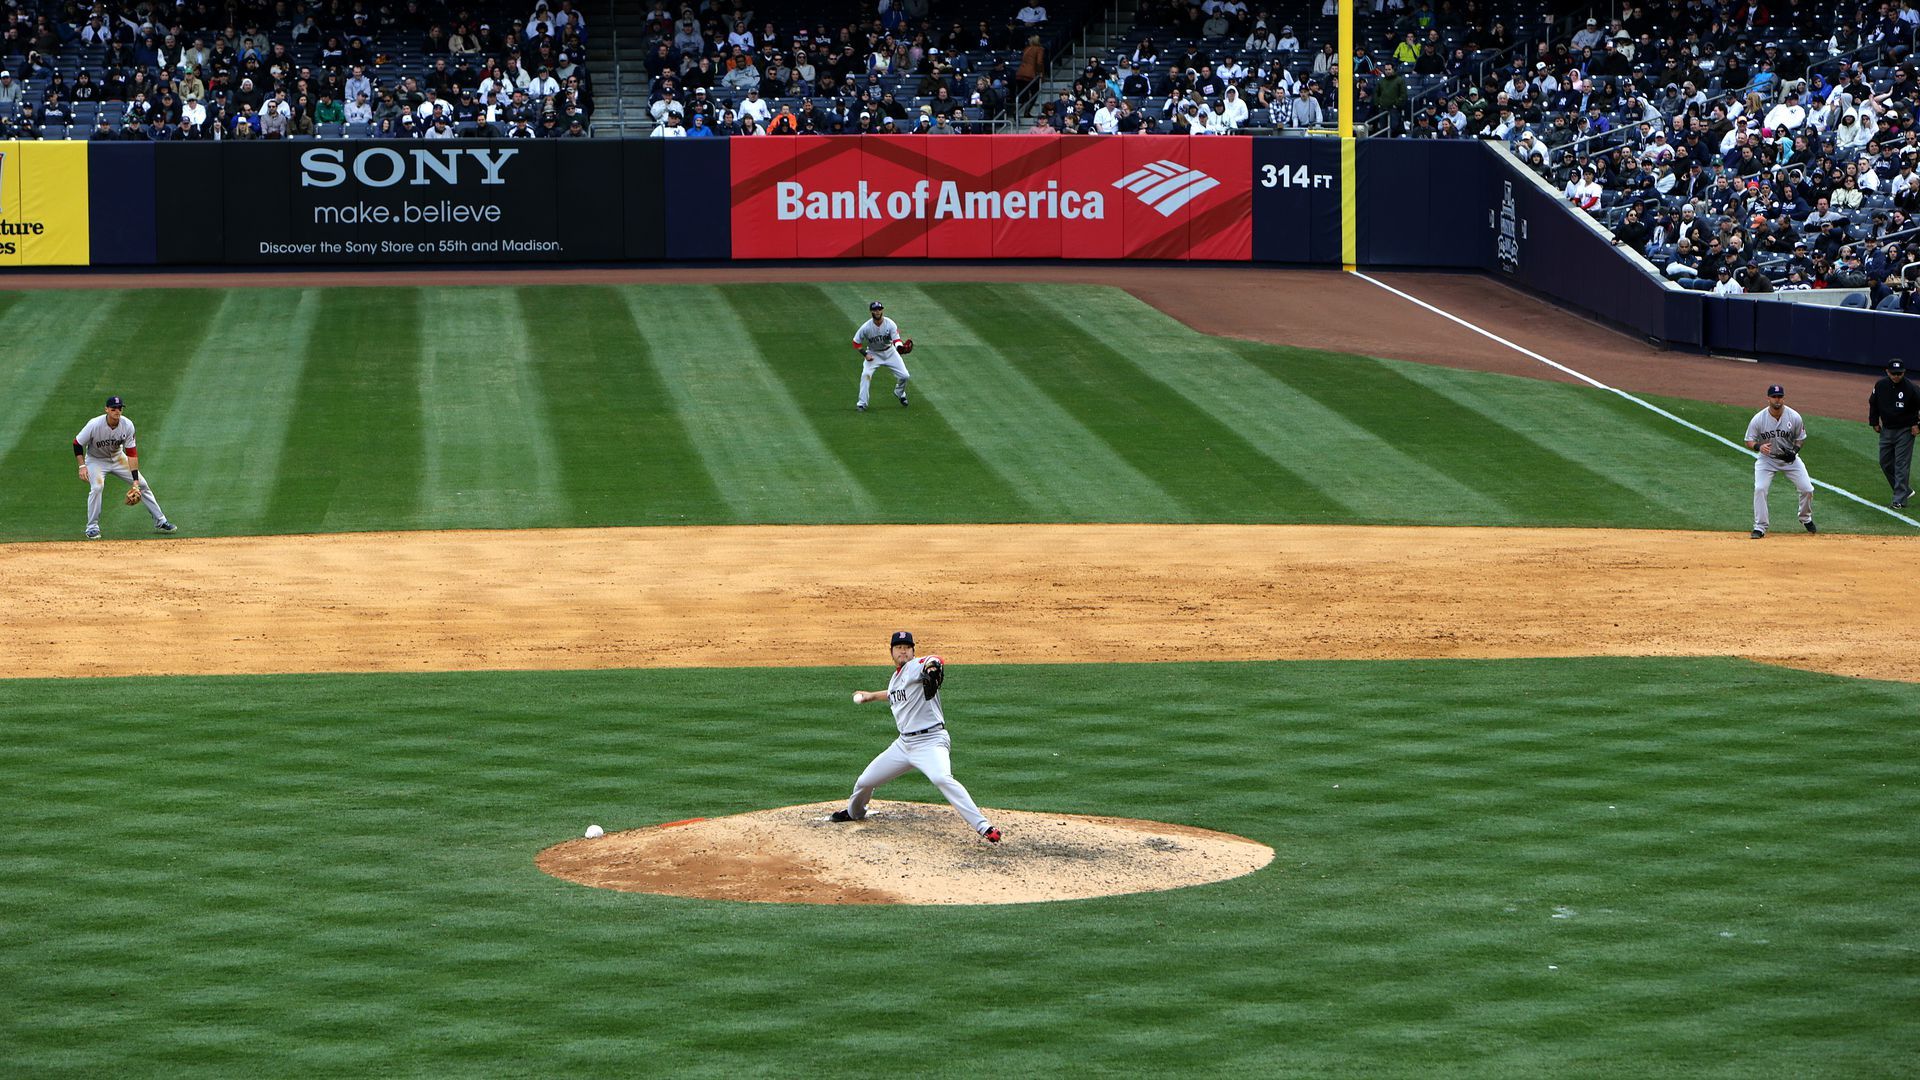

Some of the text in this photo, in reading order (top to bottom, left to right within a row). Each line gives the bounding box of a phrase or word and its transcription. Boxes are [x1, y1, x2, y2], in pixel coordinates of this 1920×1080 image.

[300, 147, 519, 187] SONY
[1261, 164, 1333, 189] 314 FT
[777, 180, 1104, 220] Bank of America
[0, 218, 45, 235] ture
[259, 239, 563, 255] Discover the Sony Store on 55th and Madison.
